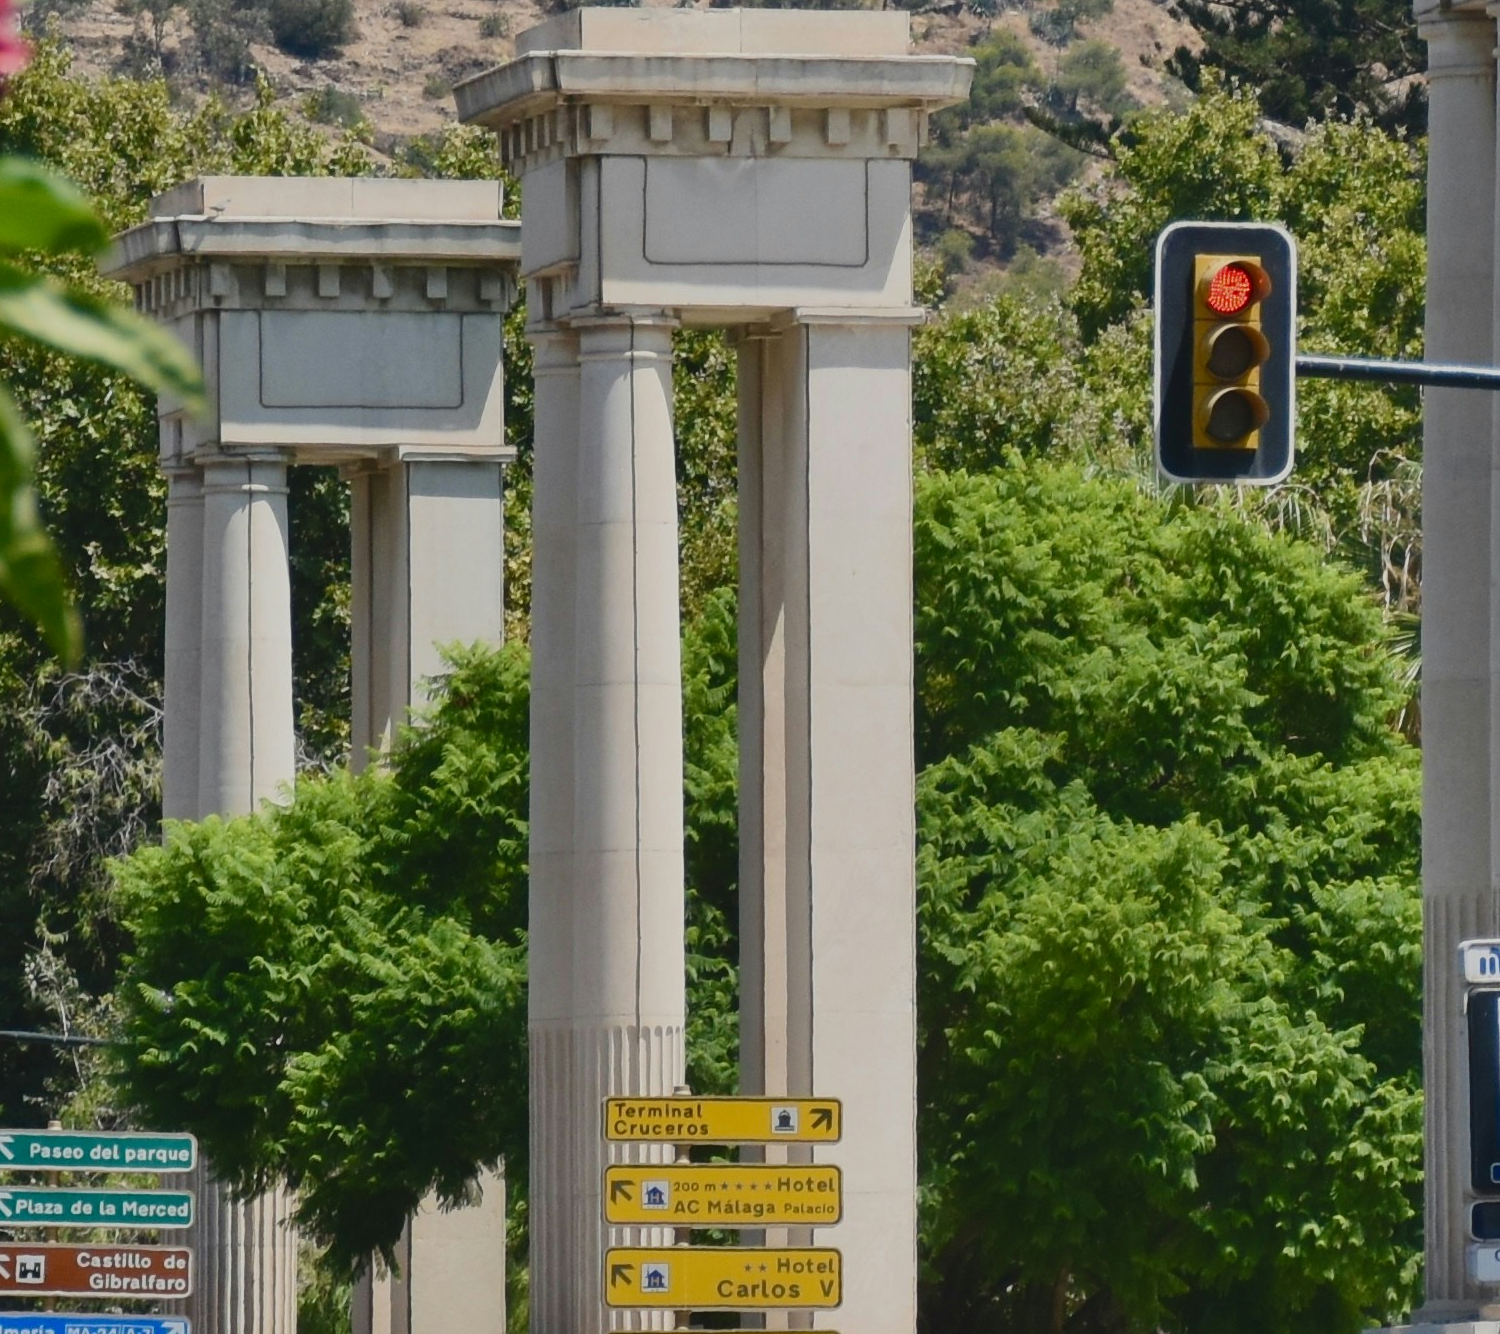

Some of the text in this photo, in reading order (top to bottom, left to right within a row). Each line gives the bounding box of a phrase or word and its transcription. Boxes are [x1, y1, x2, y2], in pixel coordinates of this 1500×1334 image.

[615, 1103, 703, 1118] Terminal
[614, 1120, 709, 1136] Cruceros
[30, 1143, 190, 1163] Paseo del parque
[673, 1177, 835, 1193] 200 m Hotel
[15, 1199, 189, 1217] Plaza de la Merced
[673, 1199, 835, 1217] AC Málaga Palacio
[77, 1253, 187, 1269] Castillo de
[777, 1258, 835, 1274] Hotel
[89, 1274, 186, 1290] Gibralfaro
[717, 1280, 835, 1298] Carlos V
